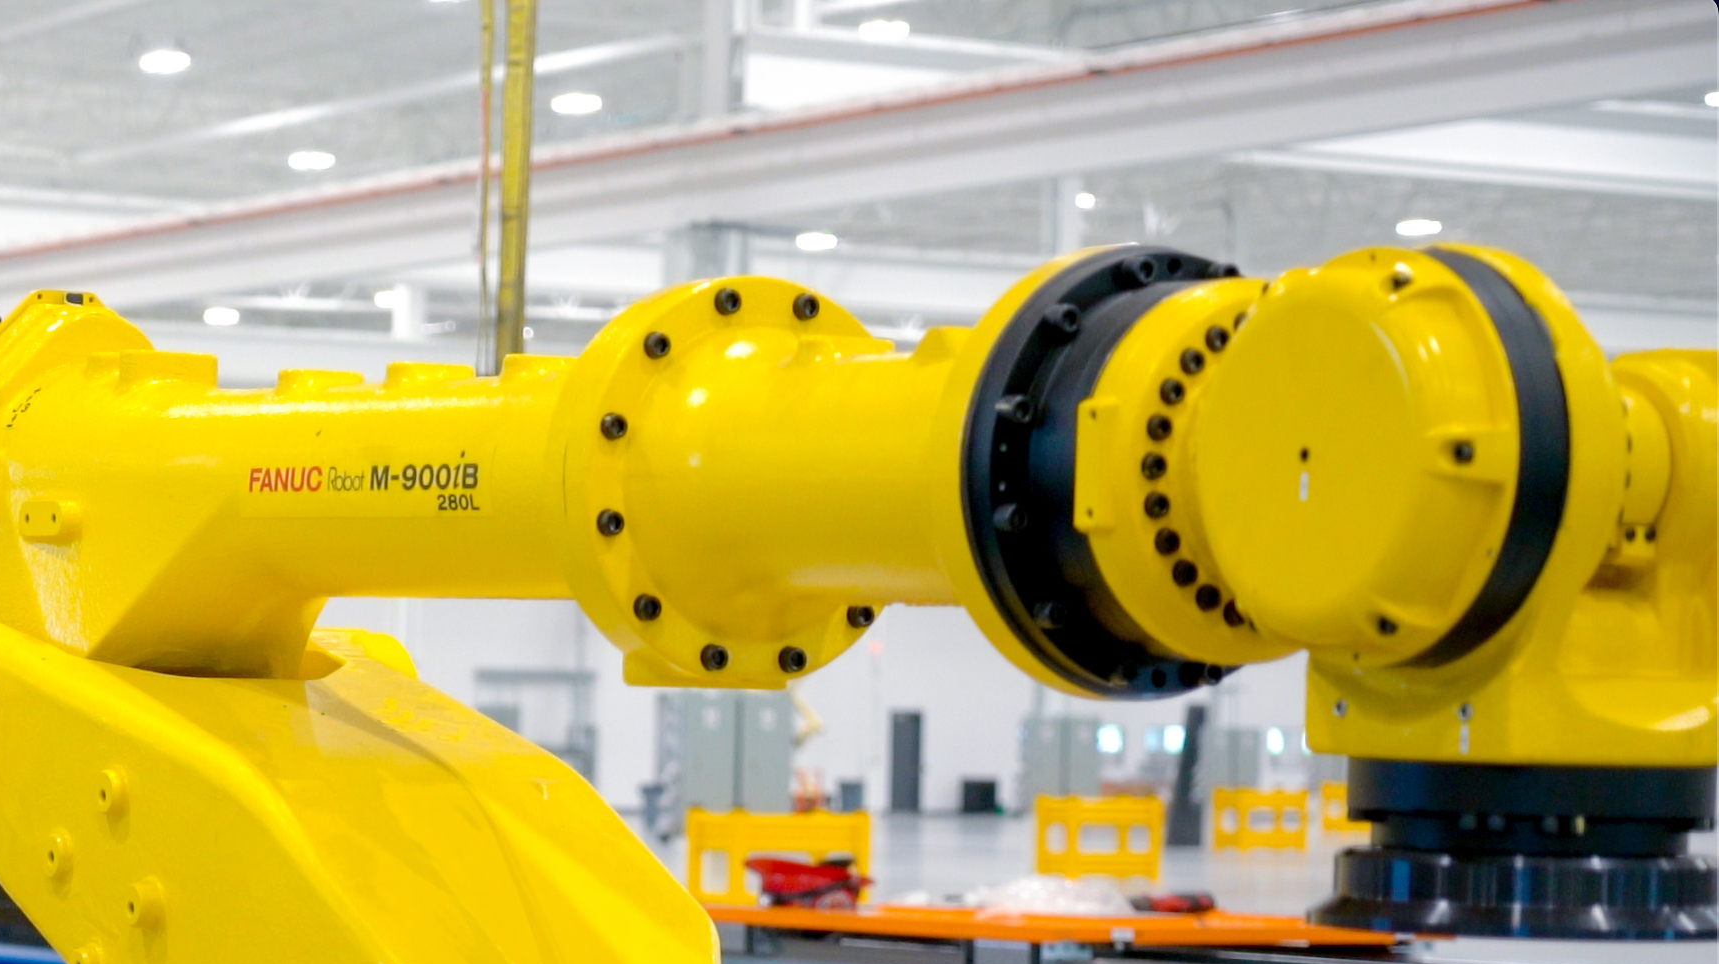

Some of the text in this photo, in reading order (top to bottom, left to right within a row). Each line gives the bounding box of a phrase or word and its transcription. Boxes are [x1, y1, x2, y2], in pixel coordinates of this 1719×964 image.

[248, 450, 480, 493] FANUC Robot M-900iB
[436, 493, 481, 511] 280L
